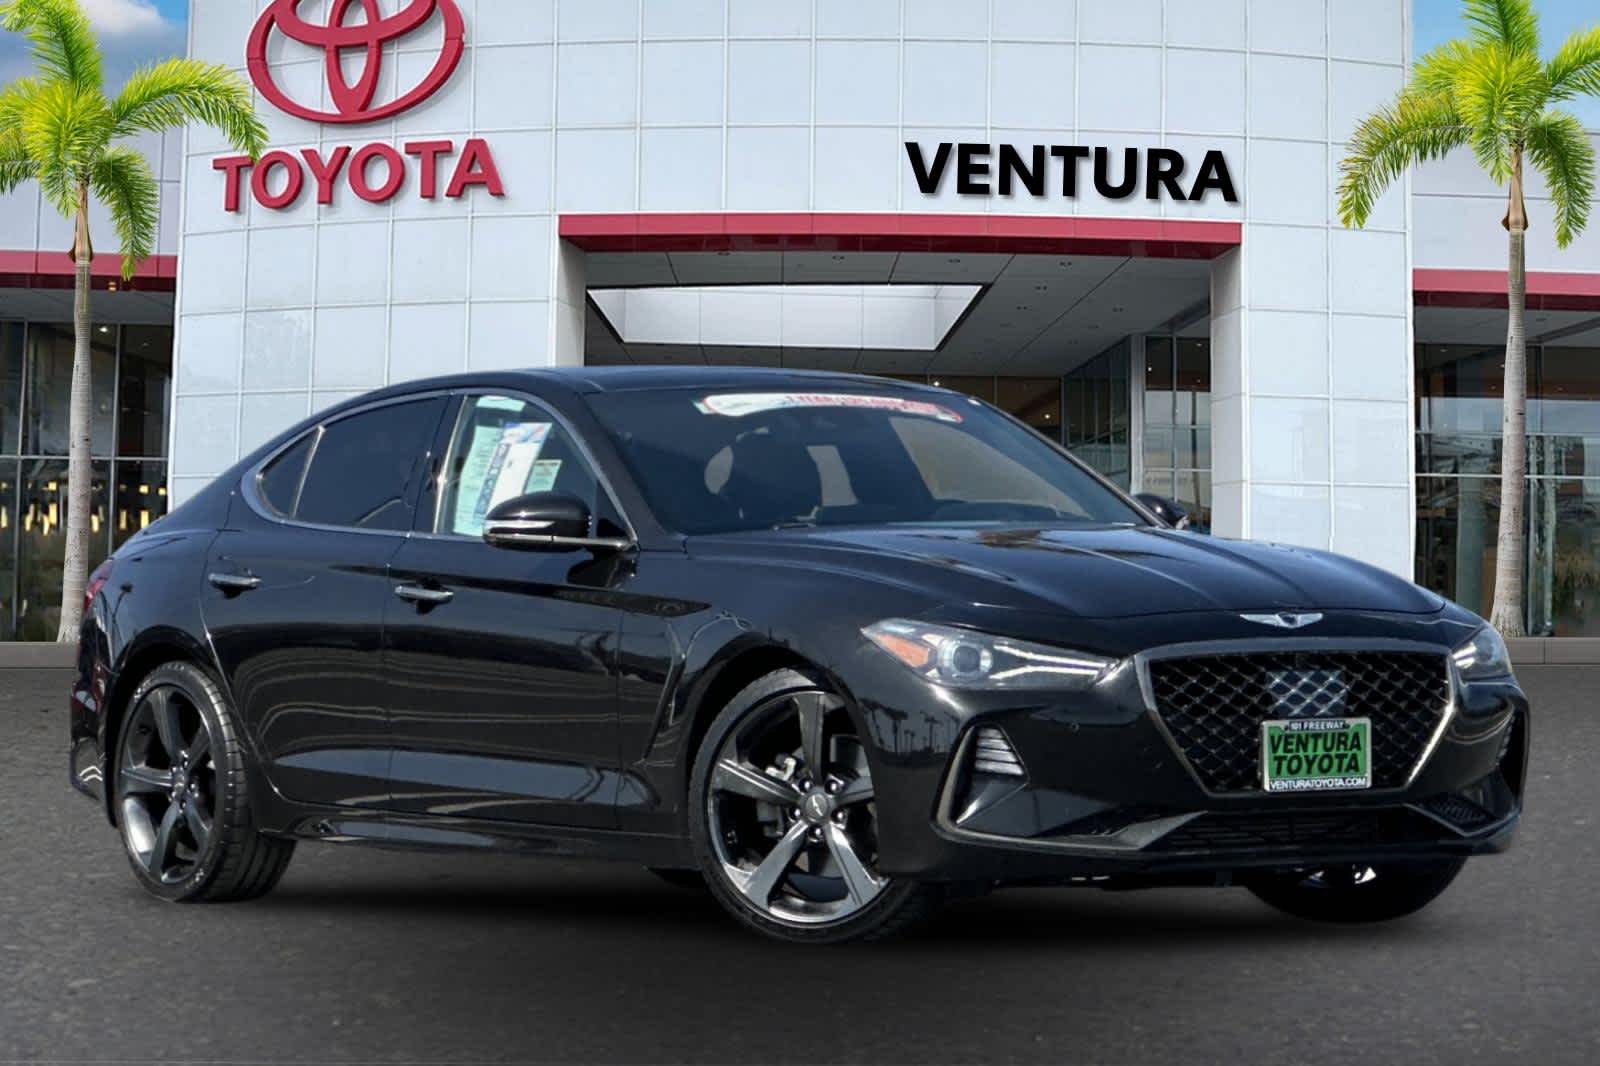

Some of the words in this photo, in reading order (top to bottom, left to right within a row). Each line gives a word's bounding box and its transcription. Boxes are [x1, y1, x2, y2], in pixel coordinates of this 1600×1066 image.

[213, 139, 504, 212] TOYOTA
[904, 142, 1239, 202] VENTURA
[1304, 720, 1344, 730] FREEWAY
[1270, 732, 1362, 754] VENTURA
[1274, 753, 1359, 775] TOYOTA
[1270, 778, 1366, 790] VENTURATOYOTA.COM
